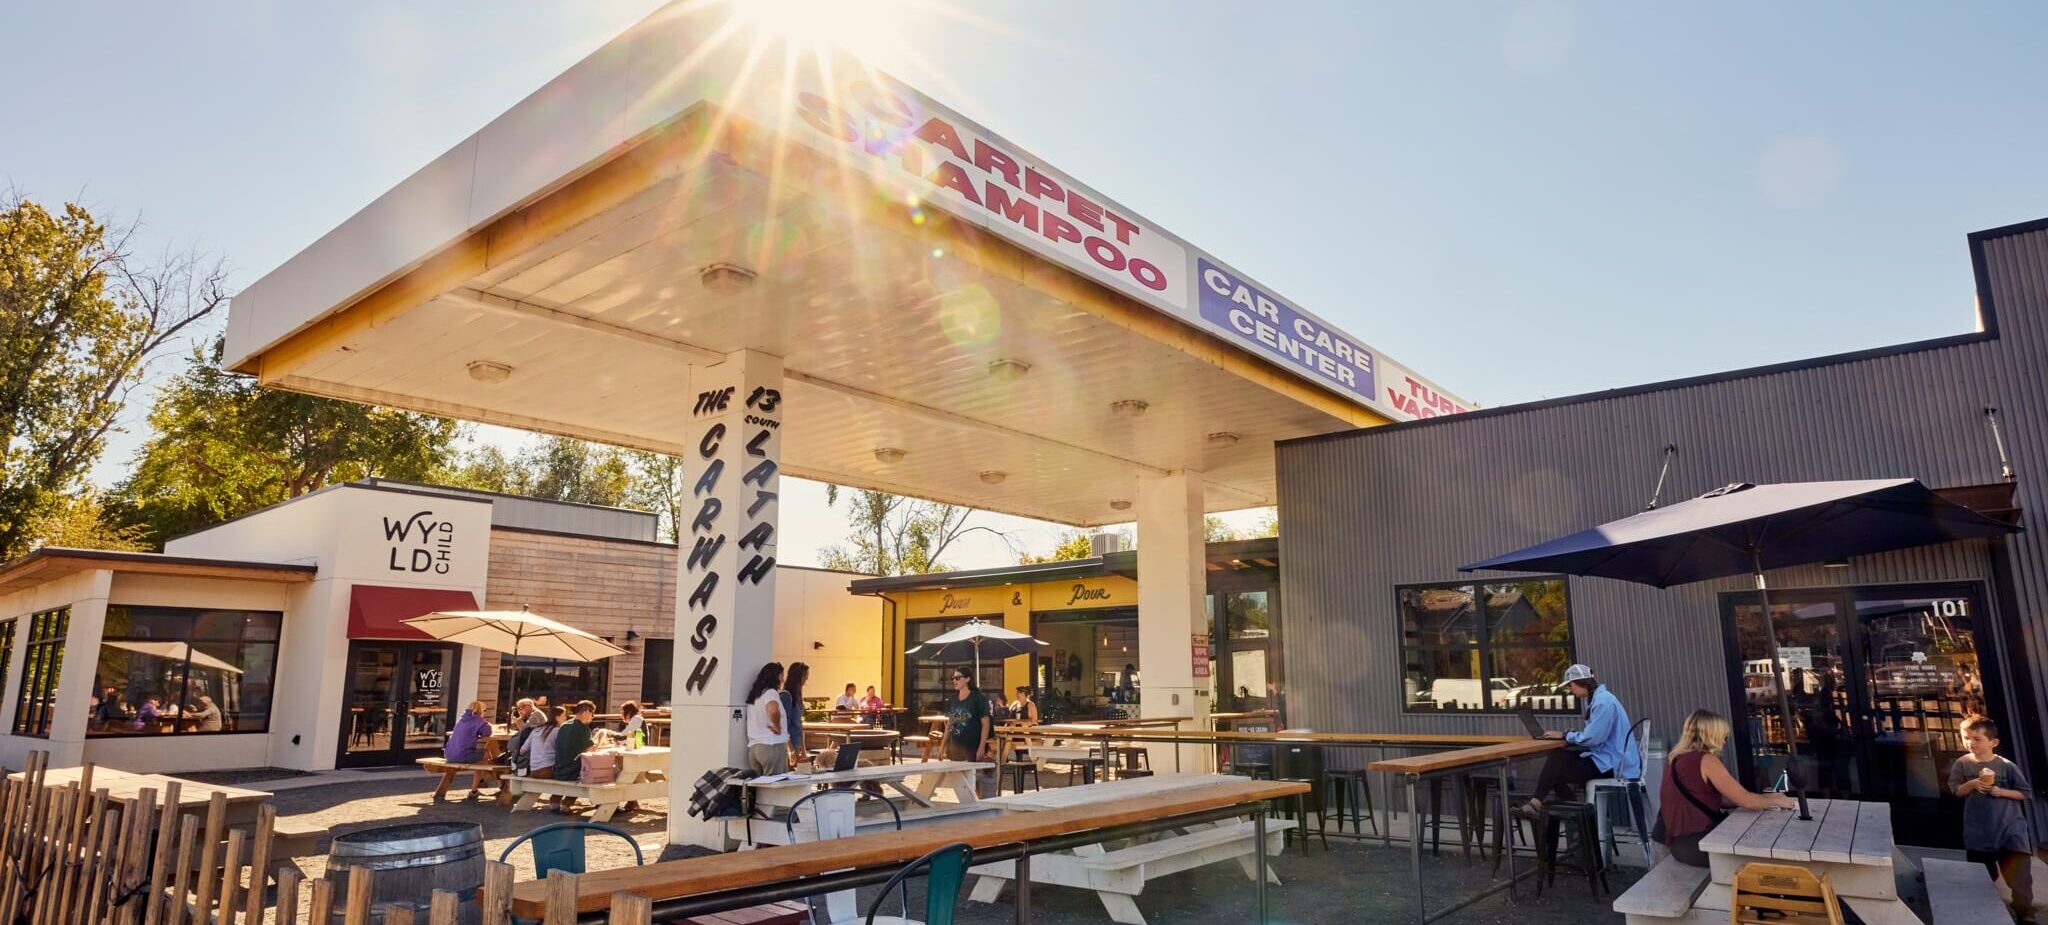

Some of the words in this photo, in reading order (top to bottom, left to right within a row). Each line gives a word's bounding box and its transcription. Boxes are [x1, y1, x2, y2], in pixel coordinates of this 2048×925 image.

[850, 80, 1141, 246] CARPET
[1204, 268, 1280, 325] CAR
[1293, 317, 1371, 374] CARE
[1228, 307, 1356, 388] CENTER
[693, 386, 735, 417] THE
[745, 386, 781, 412] 13
[744, 414, 780, 430] SOUTH
[737, 429, 778, 586] LATAH
[435, 522, 453, 574] CHILD
[1011, 592, 1023, 606] &
[1931, 600, 1967, 617] 101
